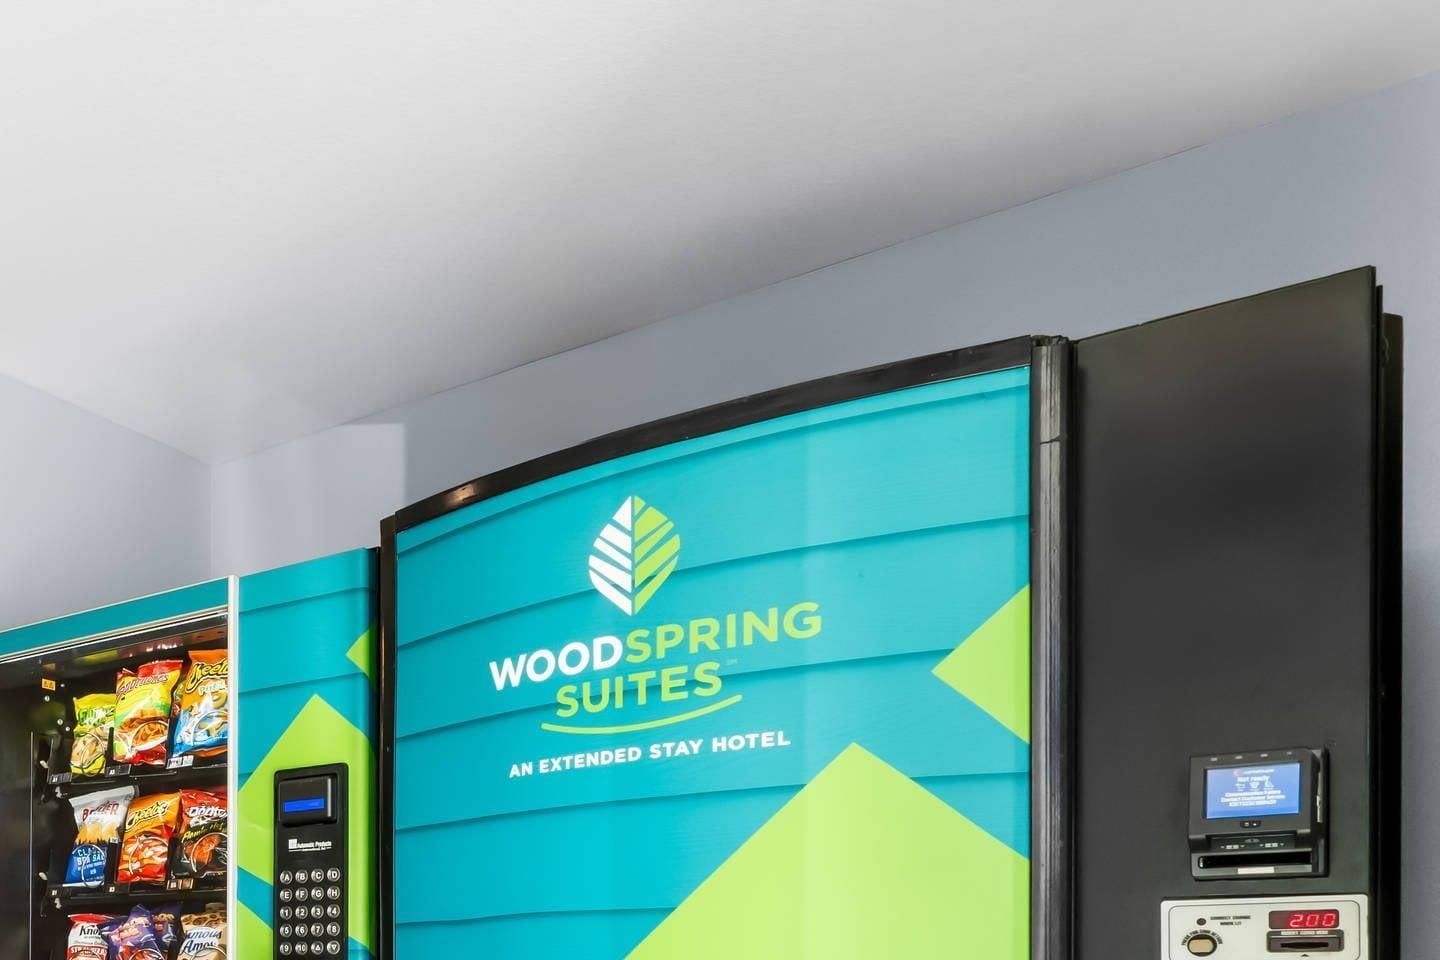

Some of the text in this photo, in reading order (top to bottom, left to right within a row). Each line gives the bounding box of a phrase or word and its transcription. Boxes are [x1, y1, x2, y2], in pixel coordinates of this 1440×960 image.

[489, 602, 822, 691] WOODSPRING
[556, 661, 723, 717] SUITES
[509, 731, 792, 778] AN EXTENDED STAY HOTEL
[316, 871, 321, 879] C
[332, 871, 338, 879] D
[284, 891, 290, 899] E
[300, 890, 305, 898] F
[285, 909, 289, 917] 1
[285, 926, 289, 934] 5
[300, 926, 305, 934] 6
[332, 925, 337, 933] 8
